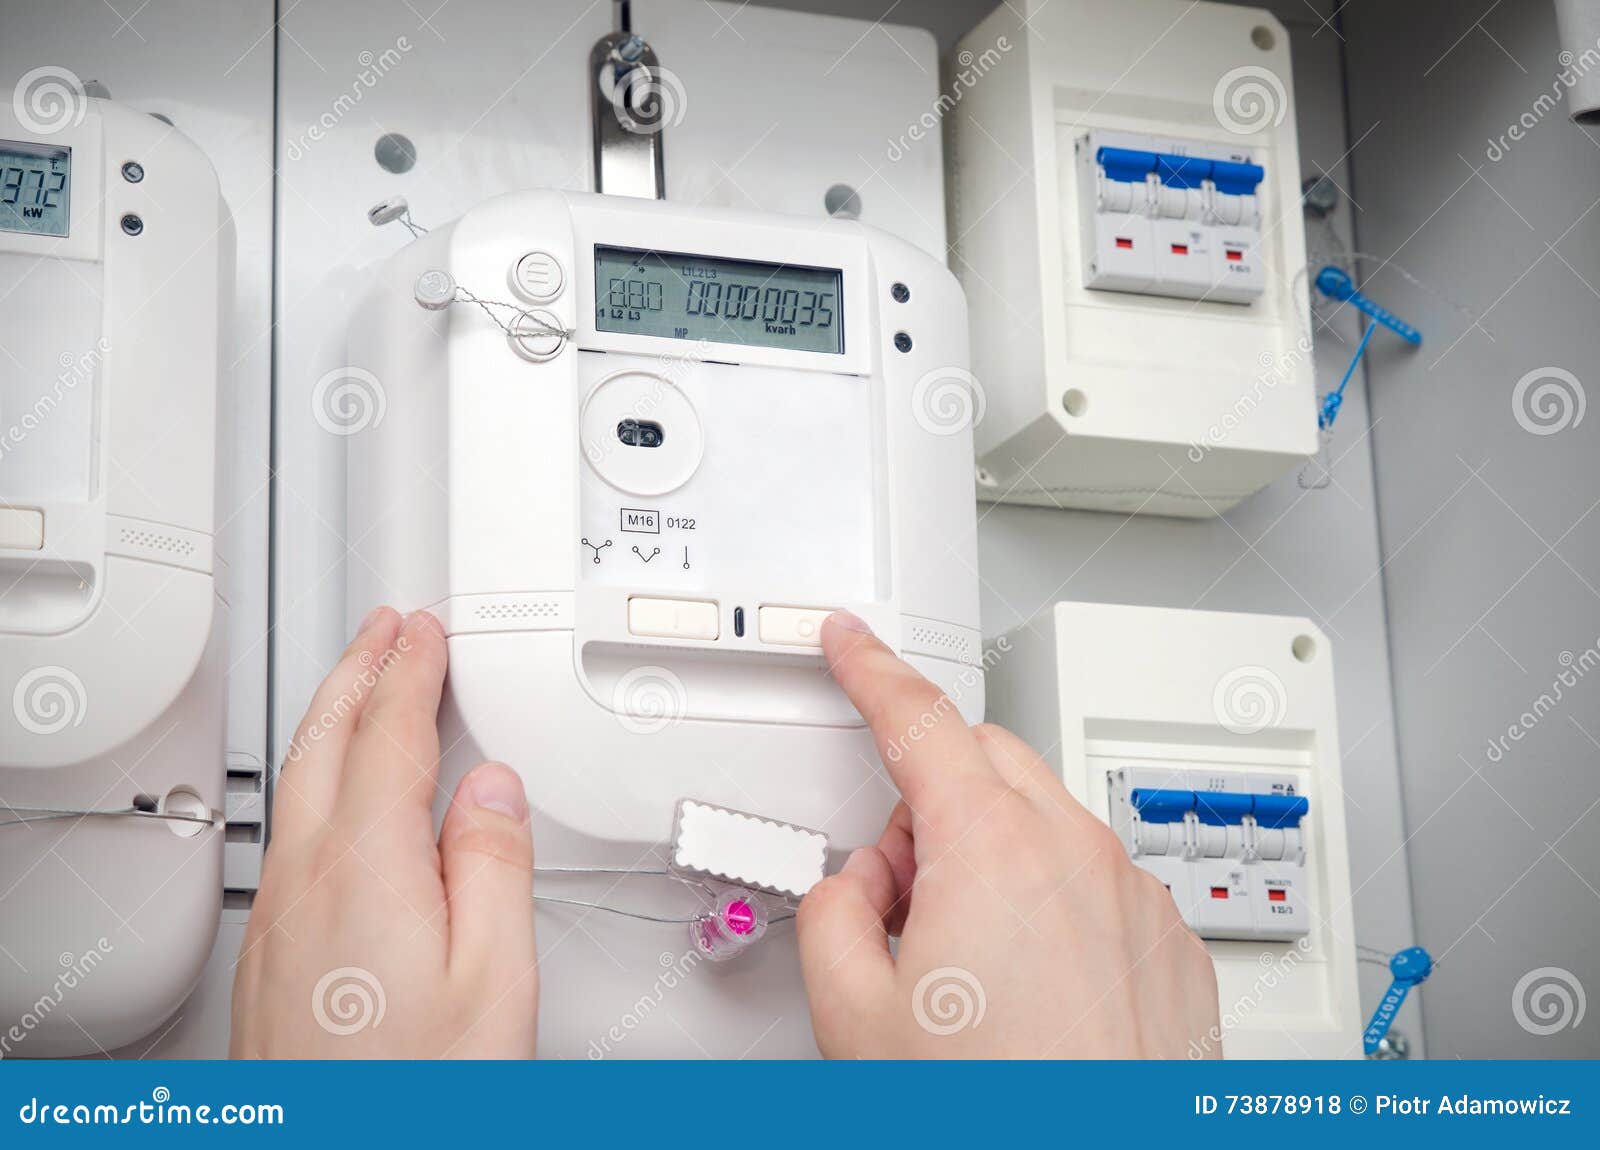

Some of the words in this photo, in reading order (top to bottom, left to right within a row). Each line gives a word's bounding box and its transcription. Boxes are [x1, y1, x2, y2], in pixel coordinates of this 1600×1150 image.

[0, 167, 66, 208] 372
[23, 207, 43, 218] kW
[686, 280, 833, 327] 00000035
[674, 327, 688, 338] MP
[765, 322, 796, 336] kvarh
[628, 514, 654, 527] M16
[666, 517, 696, 530] 0122
[1365, 987, 1405, 1045] 7007143
